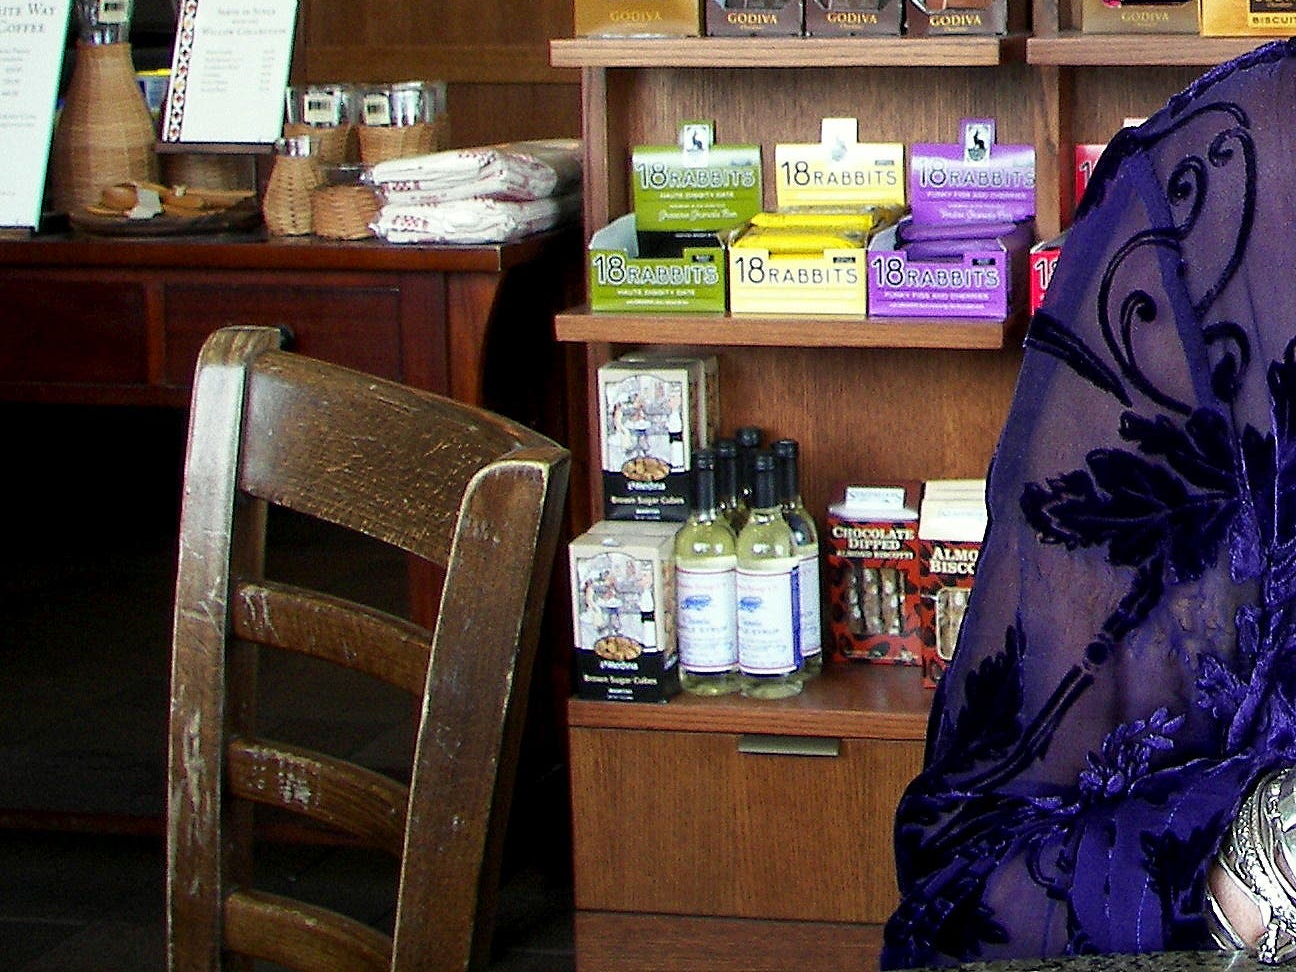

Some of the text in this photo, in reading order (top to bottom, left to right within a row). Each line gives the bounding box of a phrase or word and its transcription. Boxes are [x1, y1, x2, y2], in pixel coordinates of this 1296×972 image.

[610, 11, 663, 21] GODIVA
[727, 13, 777, 24] GODIVA
[827, 12, 878, 24] GODIVA
[929, 14, 981, 26] GODIVA
[1121, 12, 1169, 21] GODIVA
[832, 526, 915, 541] CHOCOLATE
[848, 538, 900, 551] DIPPED
